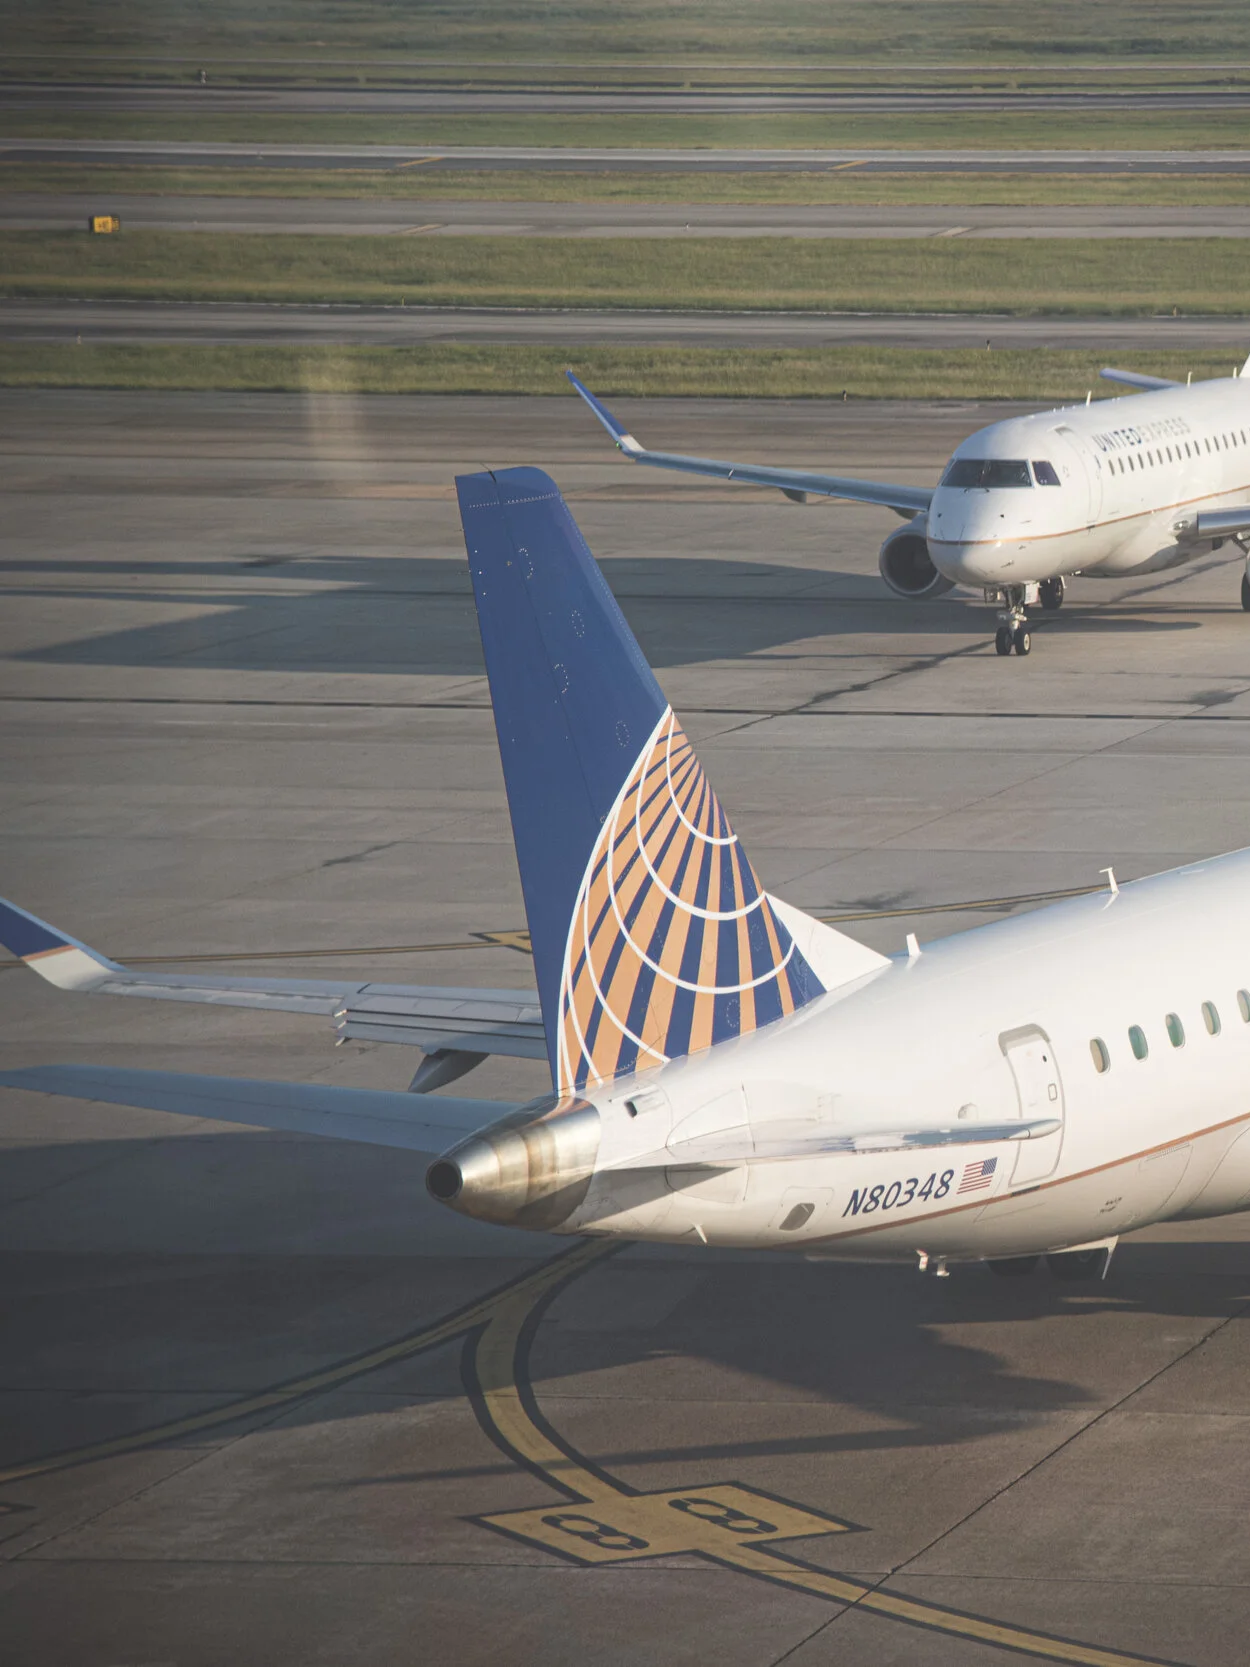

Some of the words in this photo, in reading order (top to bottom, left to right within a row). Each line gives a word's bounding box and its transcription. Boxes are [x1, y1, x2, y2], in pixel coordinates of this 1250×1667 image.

[1091, 427, 1142, 452] UNITED
[1136, 416, 1191, 443] EXPRESS
[841, 1168, 955, 1218] N80348
